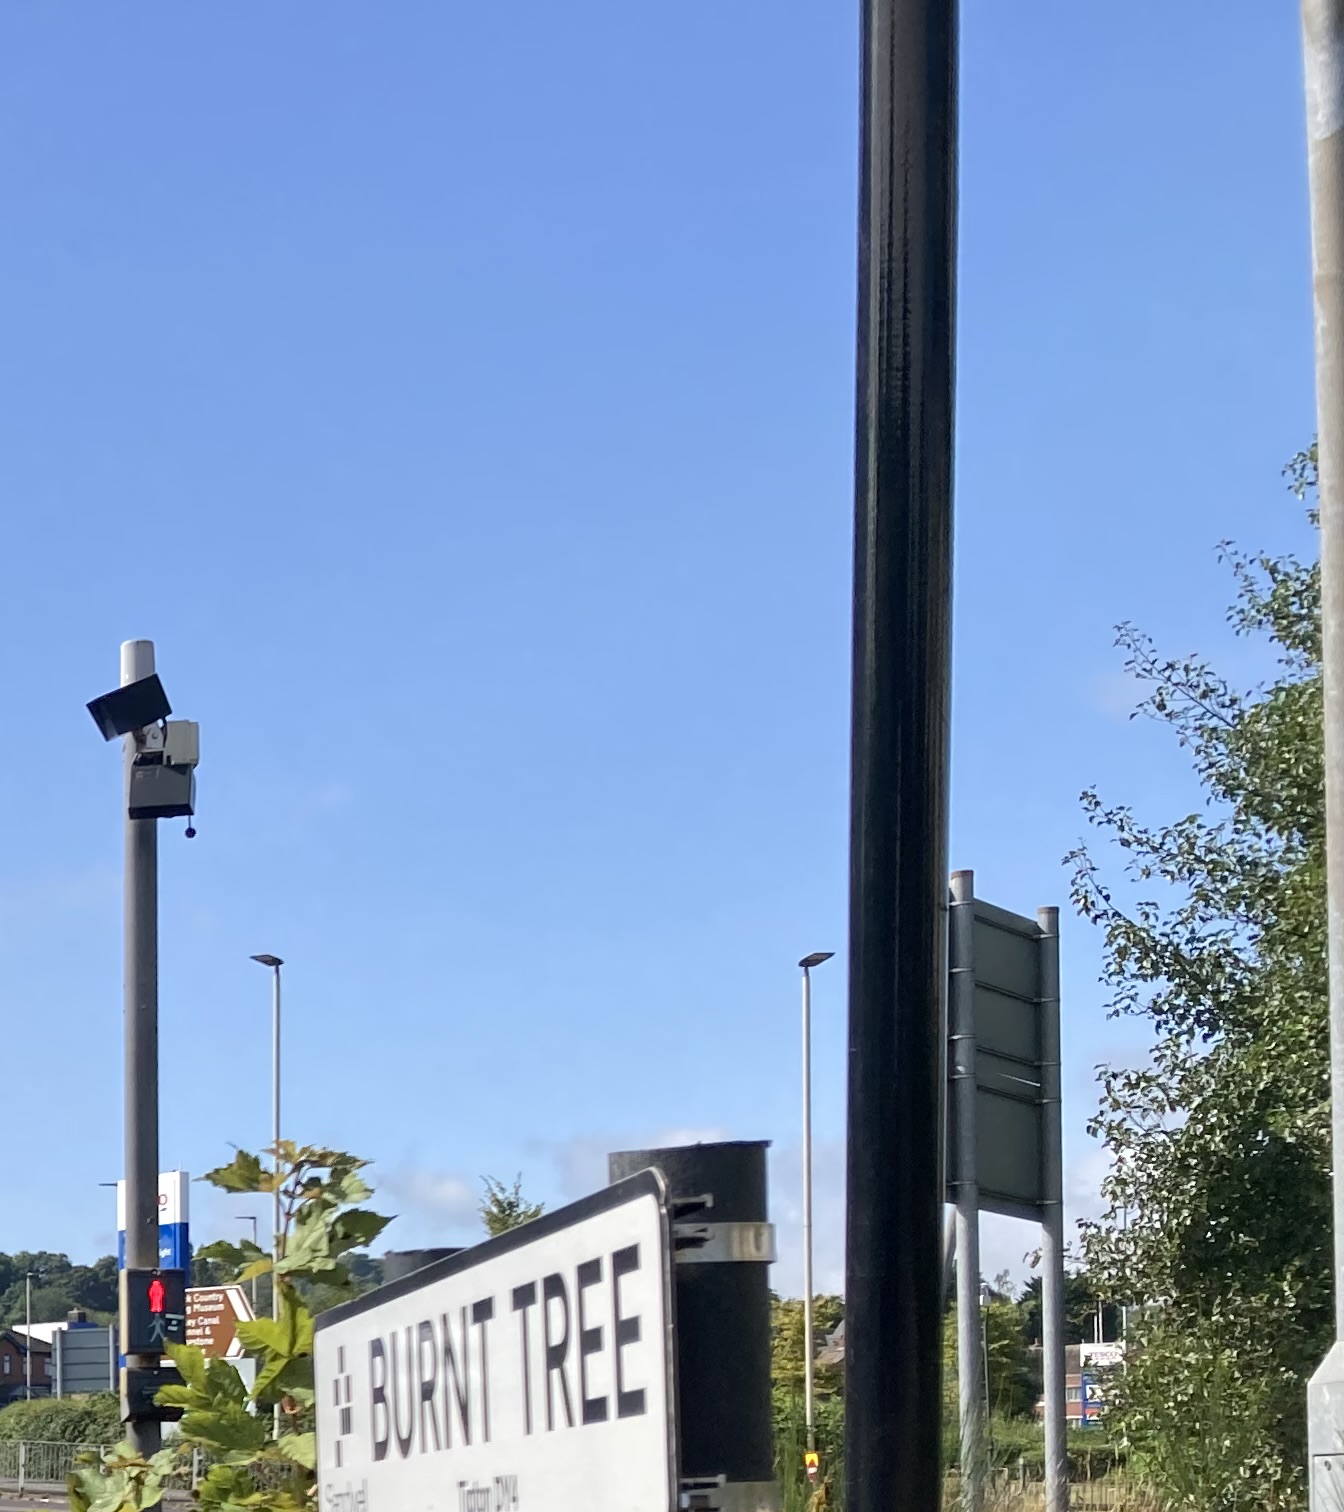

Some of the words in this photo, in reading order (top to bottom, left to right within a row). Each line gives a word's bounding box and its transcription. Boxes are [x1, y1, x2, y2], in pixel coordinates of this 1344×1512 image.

[370, 1295, 495, 1463] BURNT
[510, 1242, 647, 1436] TREE
[493, 1474, 520, 1512] DY4
